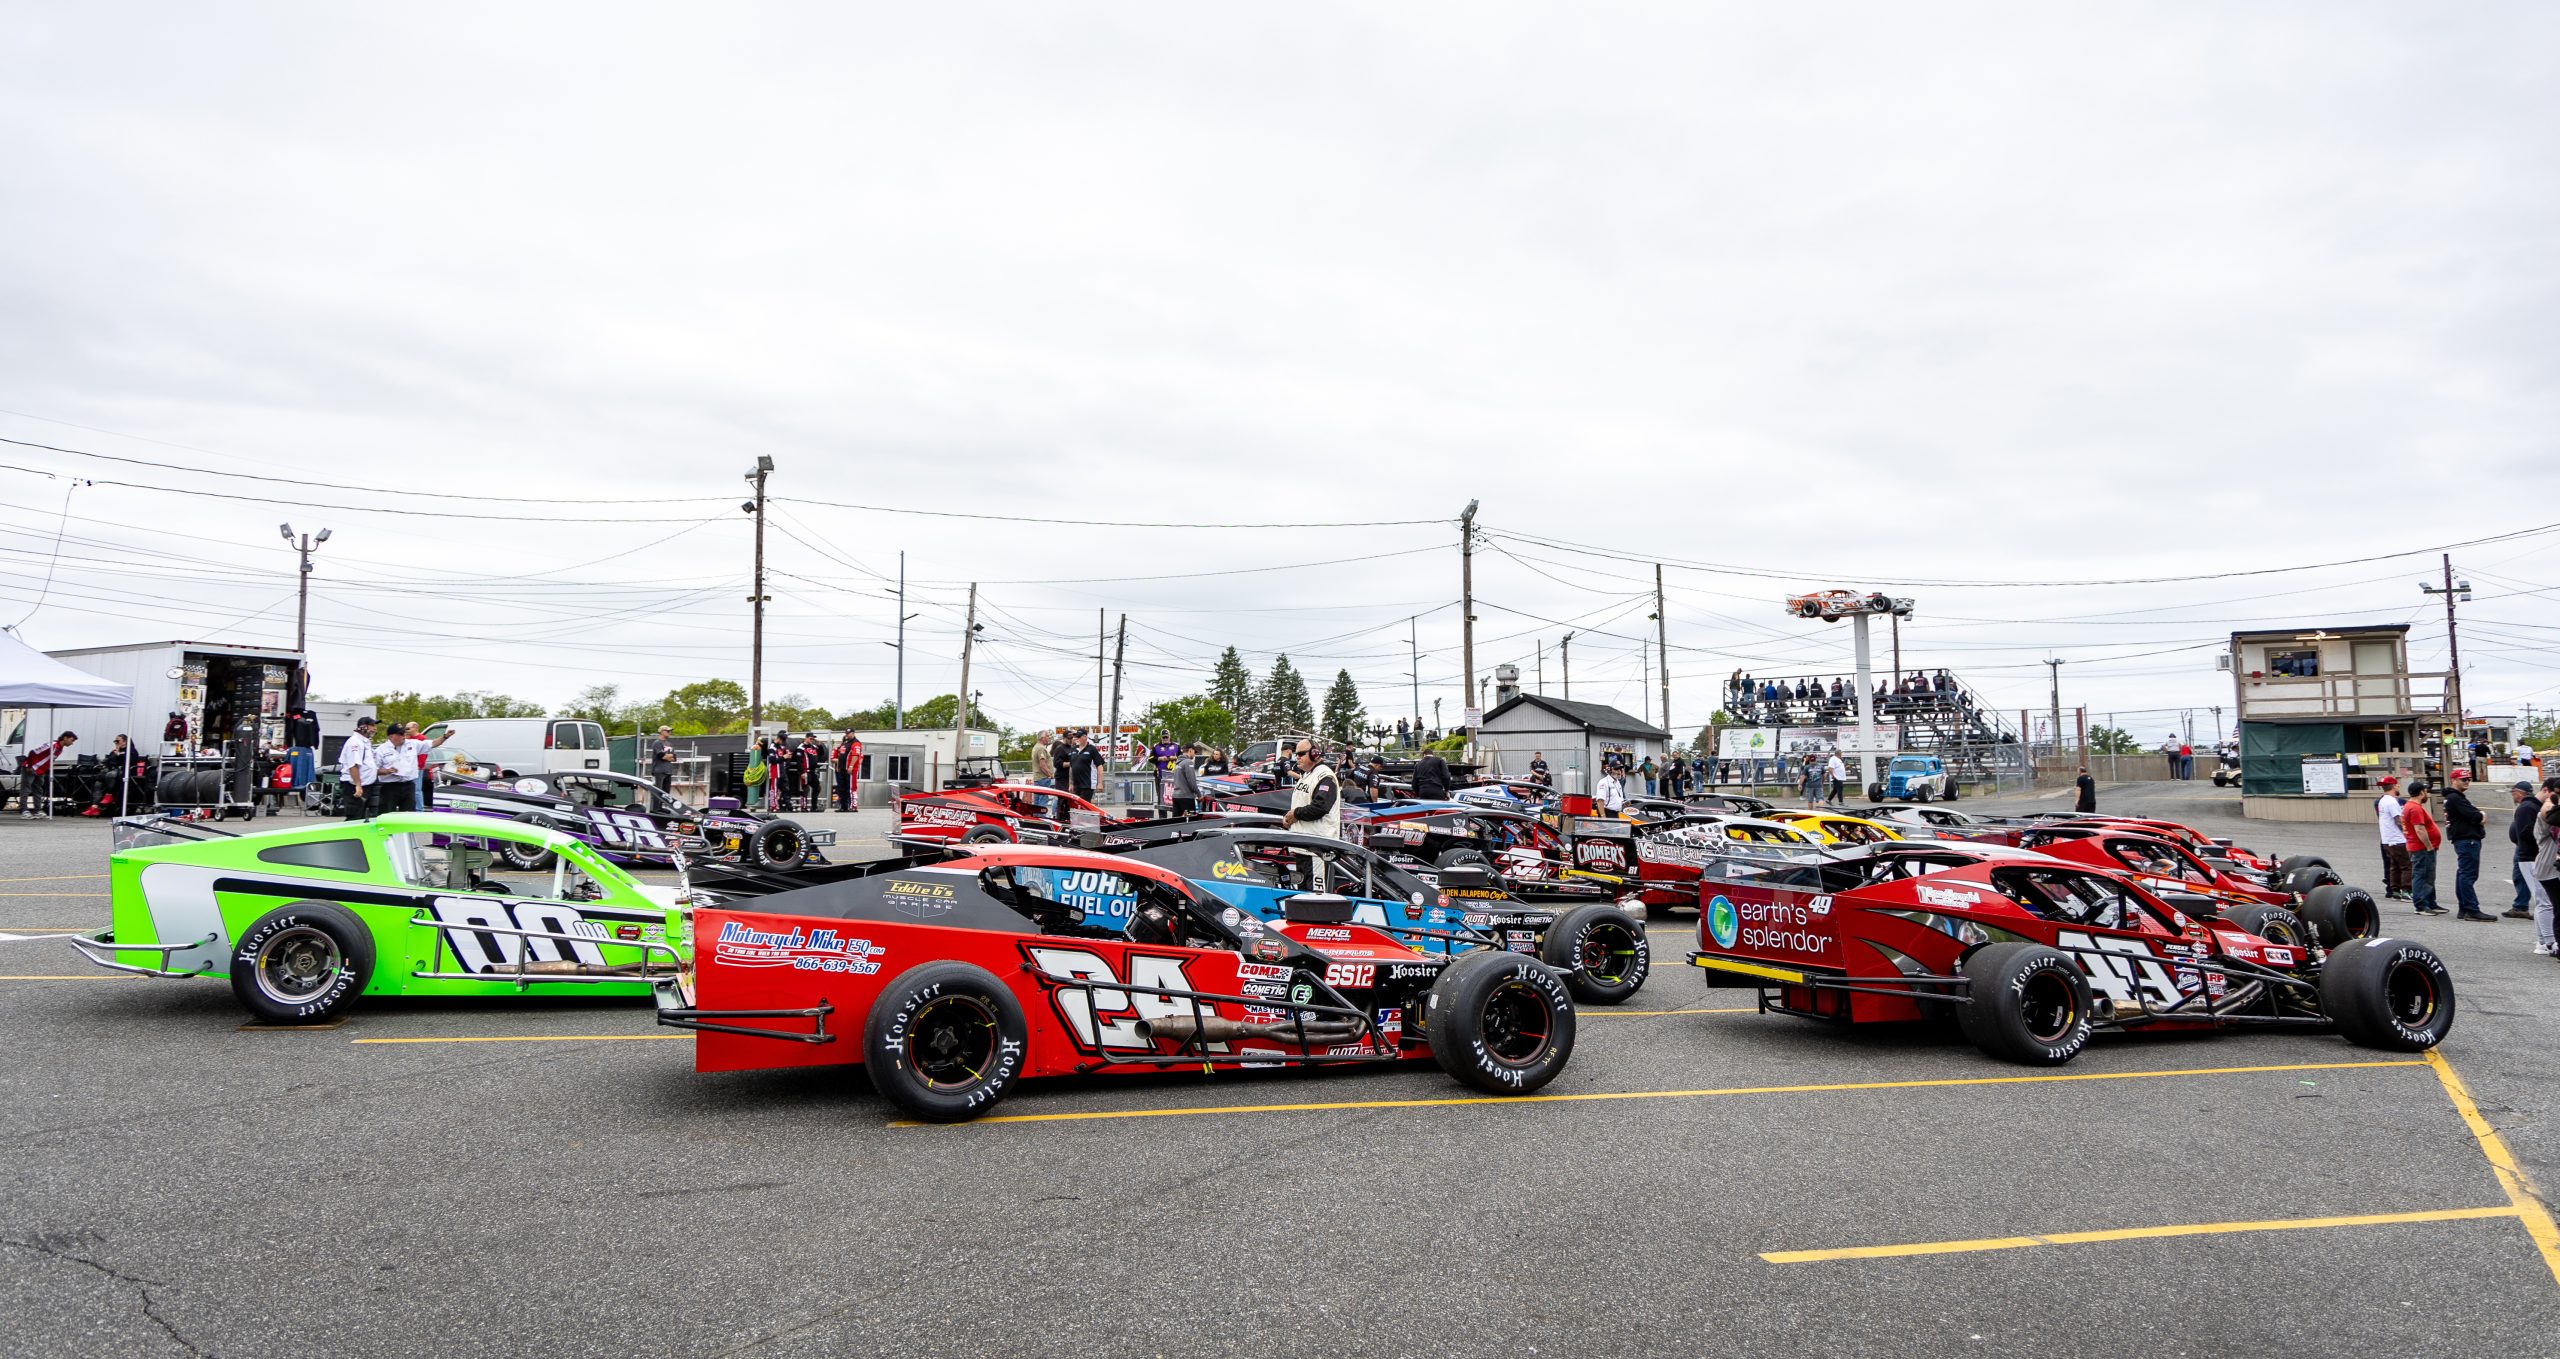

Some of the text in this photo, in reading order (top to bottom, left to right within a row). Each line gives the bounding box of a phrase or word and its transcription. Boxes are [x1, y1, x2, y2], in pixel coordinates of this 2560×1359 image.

[1389, 855, 1414, 864] Hoosier
[1452, 853, 1479, 867] Hoosier
[1577, 844, 1627, 868] CROMER'S
[890, 881, 954, 897] Eddie G's
[1740, 901, 1807, 926] earth's
[1808, 895, 1833, 915] 49
[1464, 914, 1488, 924] KLOTZ
[1489, 914, 1522, 926] Hoosier
[2261, 912, 2297, 926] Hoosier
[239, 915, 296, 966] Hoosier
[718, 922, 805, 950] Motorcycle
[806, 929, 845, 951] Mike
[1306, 928, 1351, 938] MERKEL
[1743, 927, 1828, 954] splendor
[1572, 922, 1592, 971] Hoosier
[2227, 946, 2259, 959] Hoosier
[793, 957, 881, 975] 866-639-5567
[1240, 964, 1280, 976] COMP
[1628, 939, 1648, 988] Hoosier
[2399, 948, 2444, 975] Hoosier
[1324, 963, 1438, 988] SS12 Hoosier
[1515, 964, 1568, 1011] Hoosier
[2011, 957, 2056, 999] Hoosier
[298, 966, 356, 1017] Hoosier
[1243, 983, 1287, 996] COMETIC
[885, 983, 940, 1054] Hoosier
[1251, 1005, 1286, 1014] MASTER
[2048, 1018, 2092, 1059] Hoosier
[2392, 1018, 2436, 1045] Hoosier
[968, 1036, 1021, 1107] Hoosier
[1473, 1040, 1527, 1088] Hoosier
